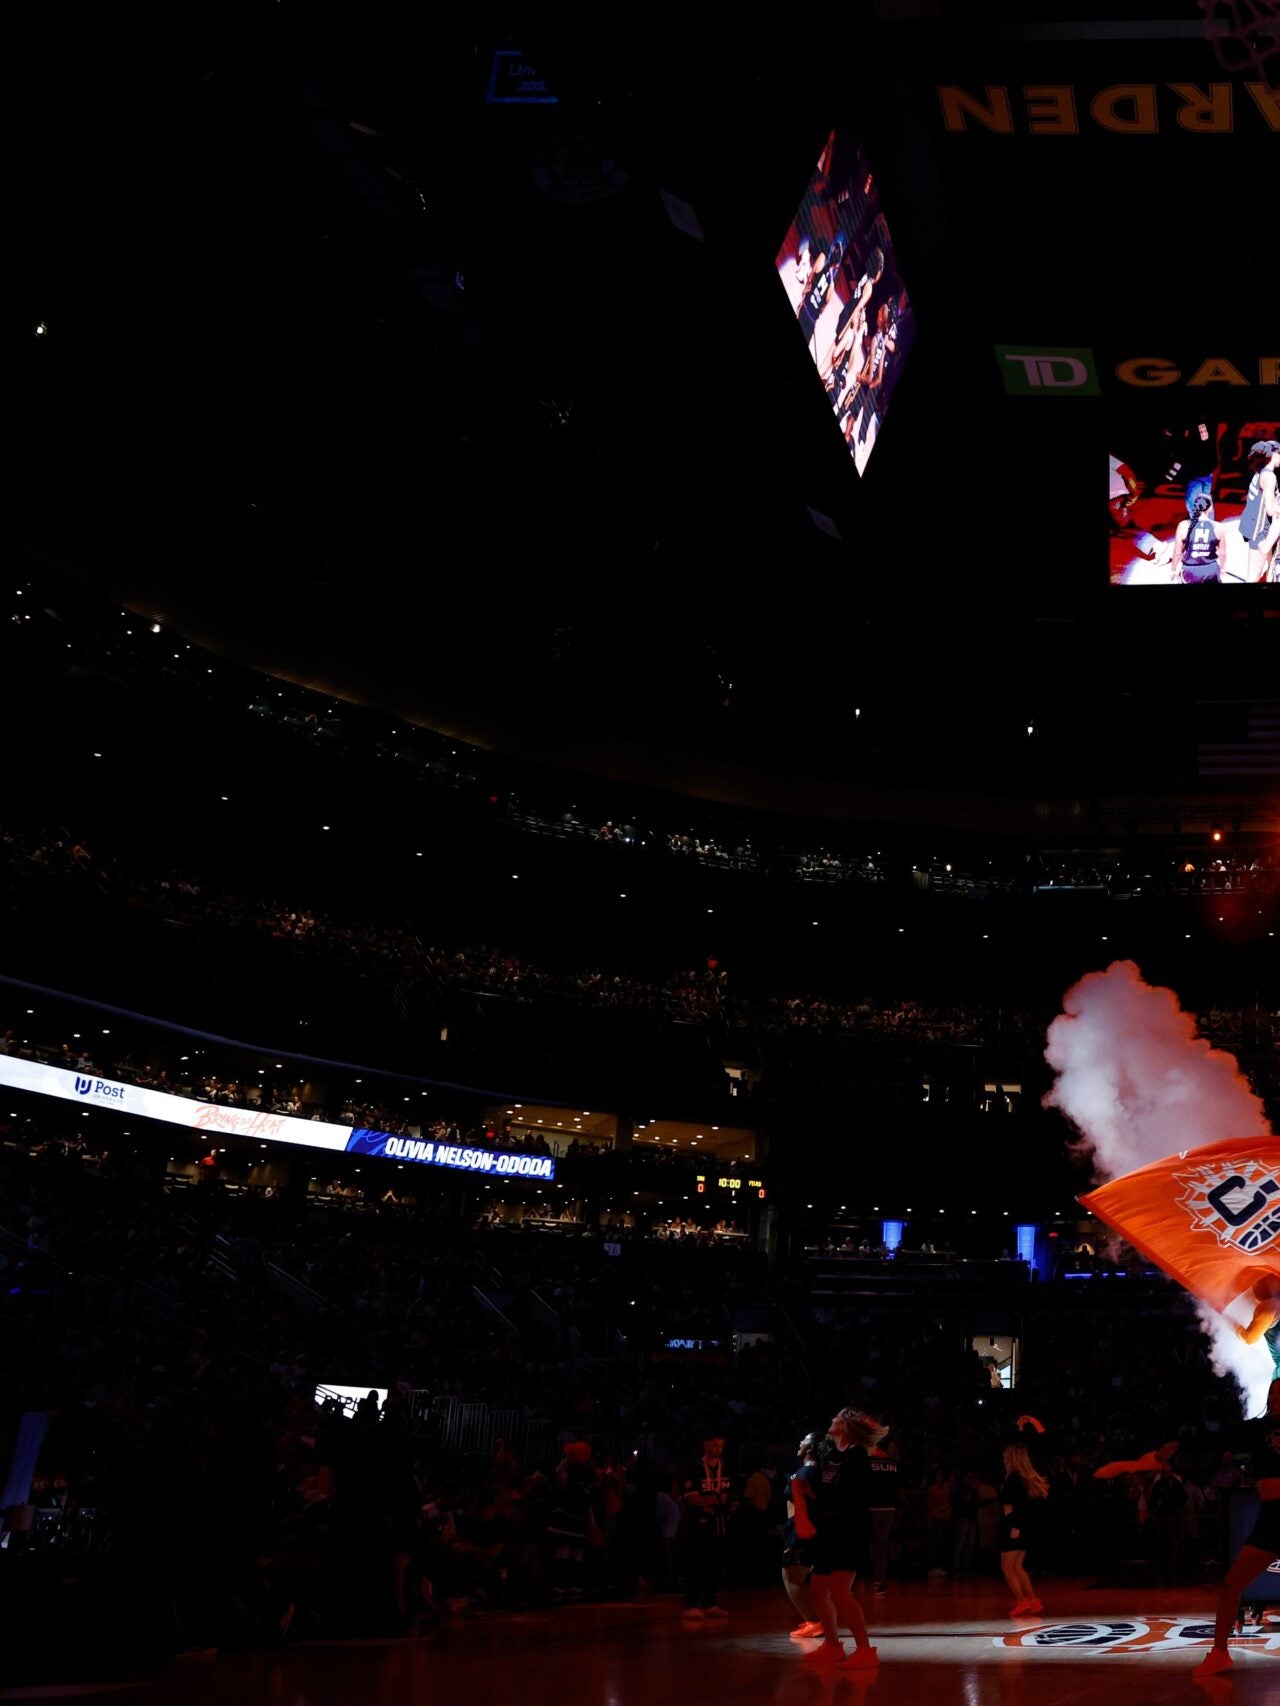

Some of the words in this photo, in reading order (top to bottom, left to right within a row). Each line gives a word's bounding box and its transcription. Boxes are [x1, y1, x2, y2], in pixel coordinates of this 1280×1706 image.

[1005, 354, 1088, 387] TD
[94, 1080, 126, 1099] Post
[385, 1137, 434, 1162] OLIVIA
[435, 1145, 552, 1178] NELSON-ODODA
[697, 1183, 704, 1193] 0
[758, 1189, 765, 1199] 0
[718, 1178, 741, 1188] 10:00
[870, 1463, 897, 1473] SUN
